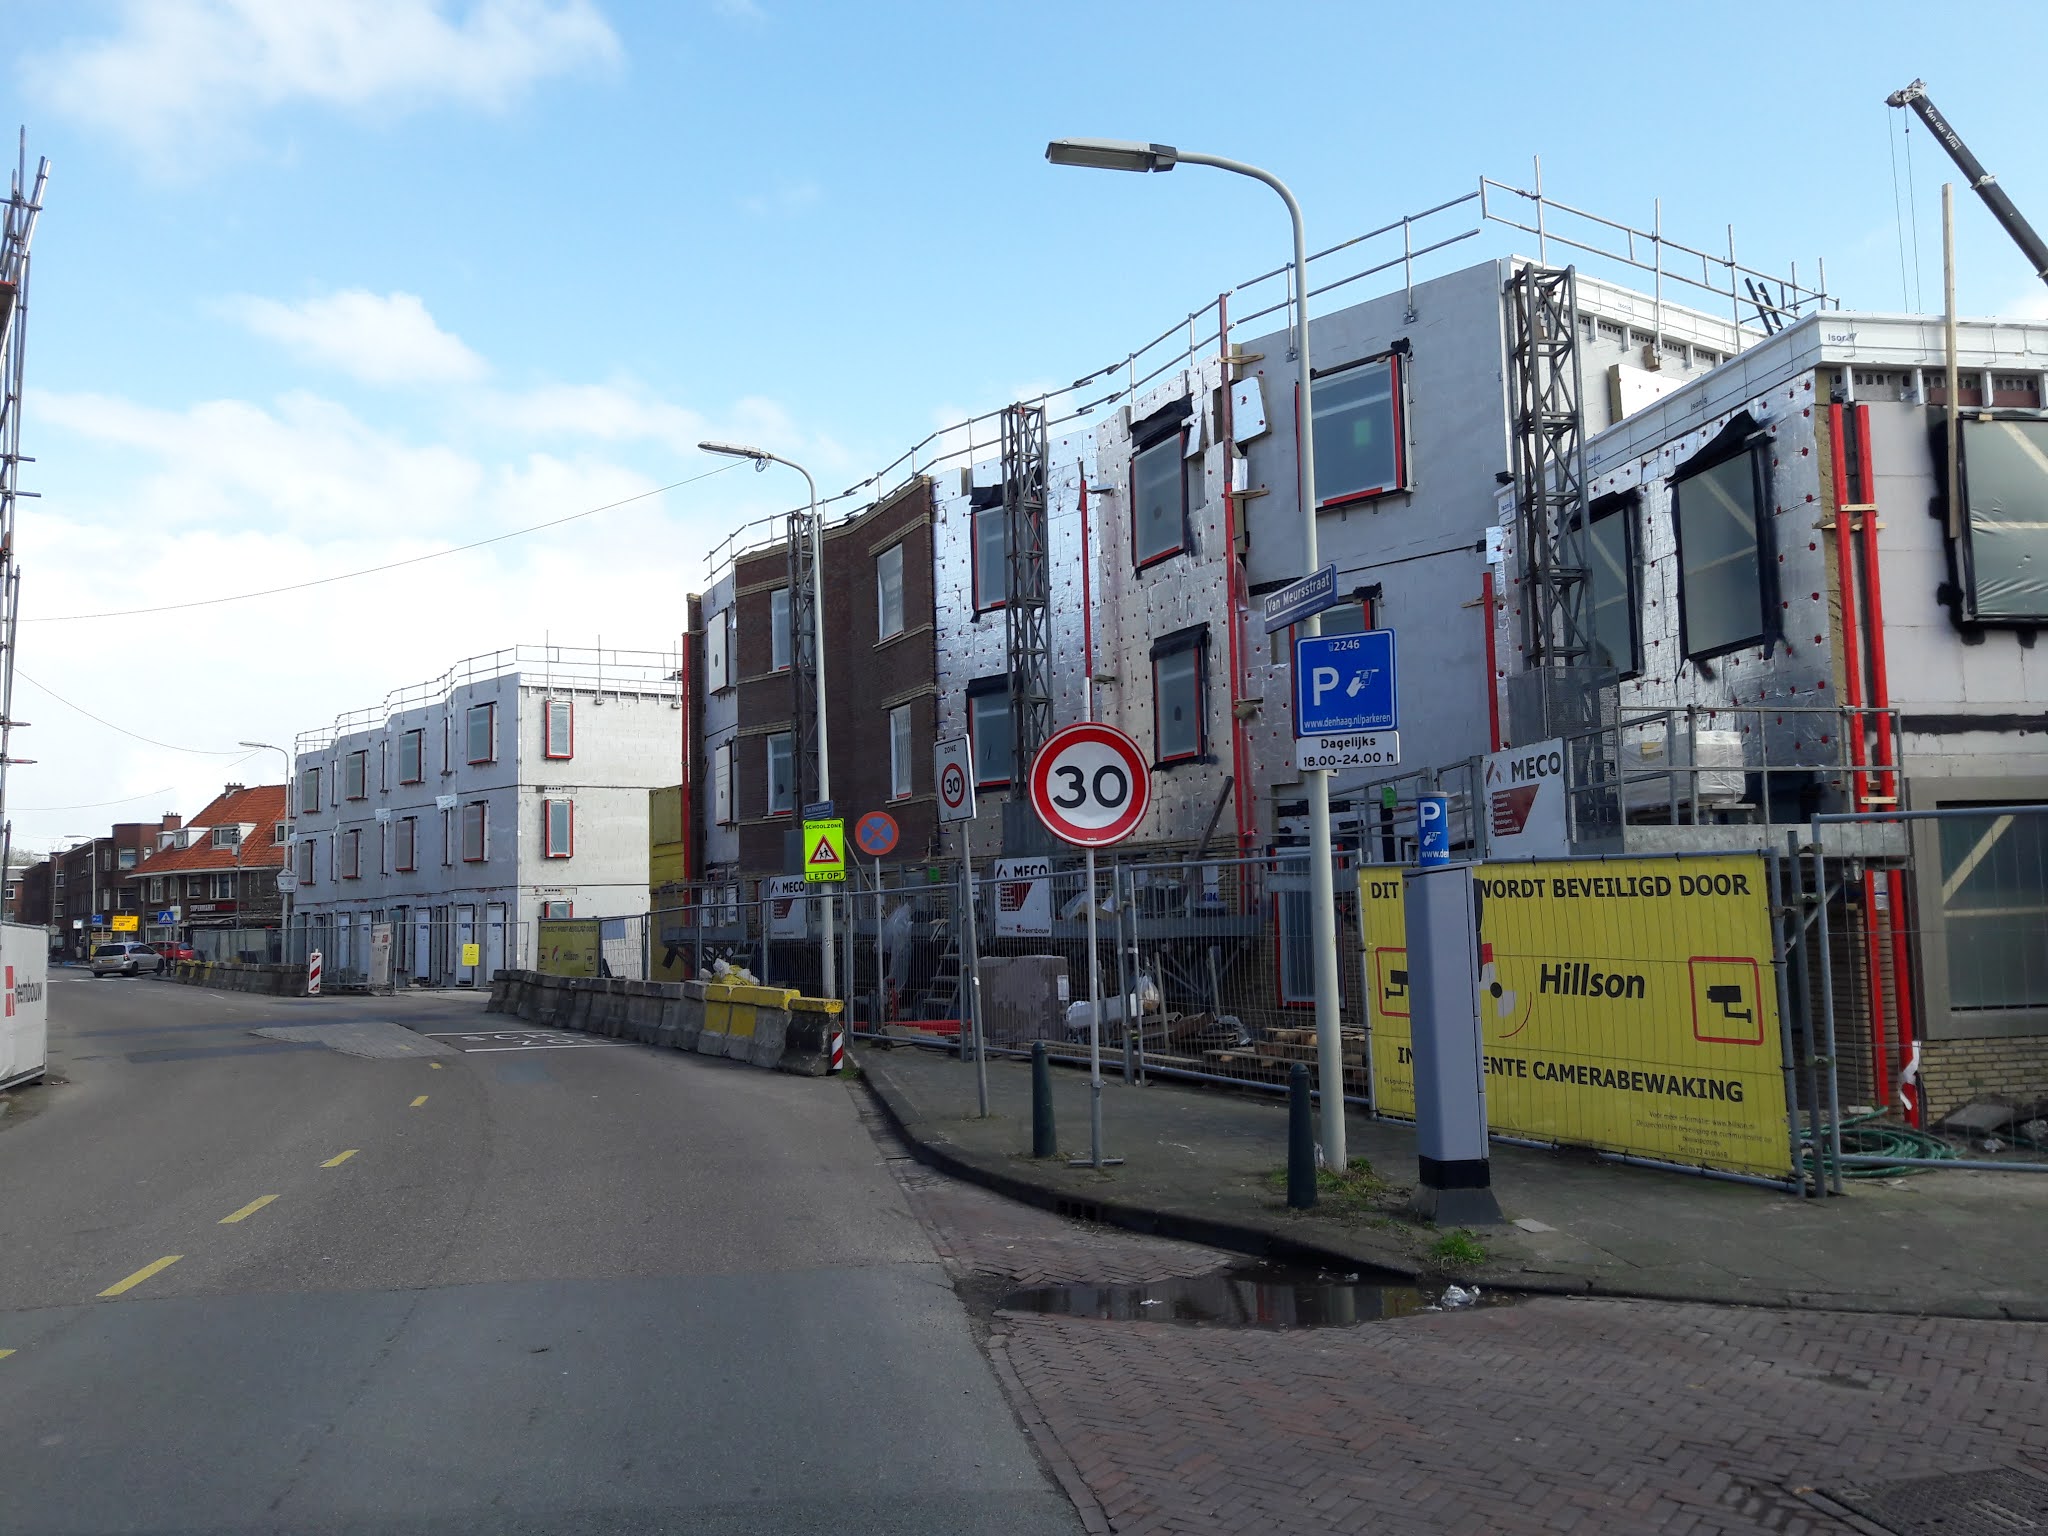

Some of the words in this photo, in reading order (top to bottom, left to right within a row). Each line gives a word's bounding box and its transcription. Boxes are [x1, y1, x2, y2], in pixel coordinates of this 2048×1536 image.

[1925, 106, 1936, 122] Van
[1267, 599, 1280, 613] Van
[1283, 572, 1330, 606] Meursstraat
[1333, 639, 1360, 651] 2246
[1312, 666, 1340, 706] P
[1304, 713, 1391, 729] www.denhaag.nl/parkeren
[944, 744, 957, 754] ZONE
[1321, 736, 1376, 750] Dagelijks
[1304, 752, 1381, 767] 18.00-24.00
[1386, 752, 1394, 762] h
[1511, 751, 1561, 782] MECO
[946, 777, 960, 794] 30
[1053, 765, 1128, 809] 30
[1420, 801, 1440, 827] P
[809, 872, 826, 880] LET
[827, 872, 842, 880] OP!
[783, 881, 804, 893] MECO
[1371, 881, 1399, 899] DIT
[1553, 876, 1672, 898] BEVEILIGD
[1680, 874, 1750, 896] DOOR
[1540, 962, 1645, 998] Hillson
[1533, 1060, 1743, 1102] CAMERABEWAKING
